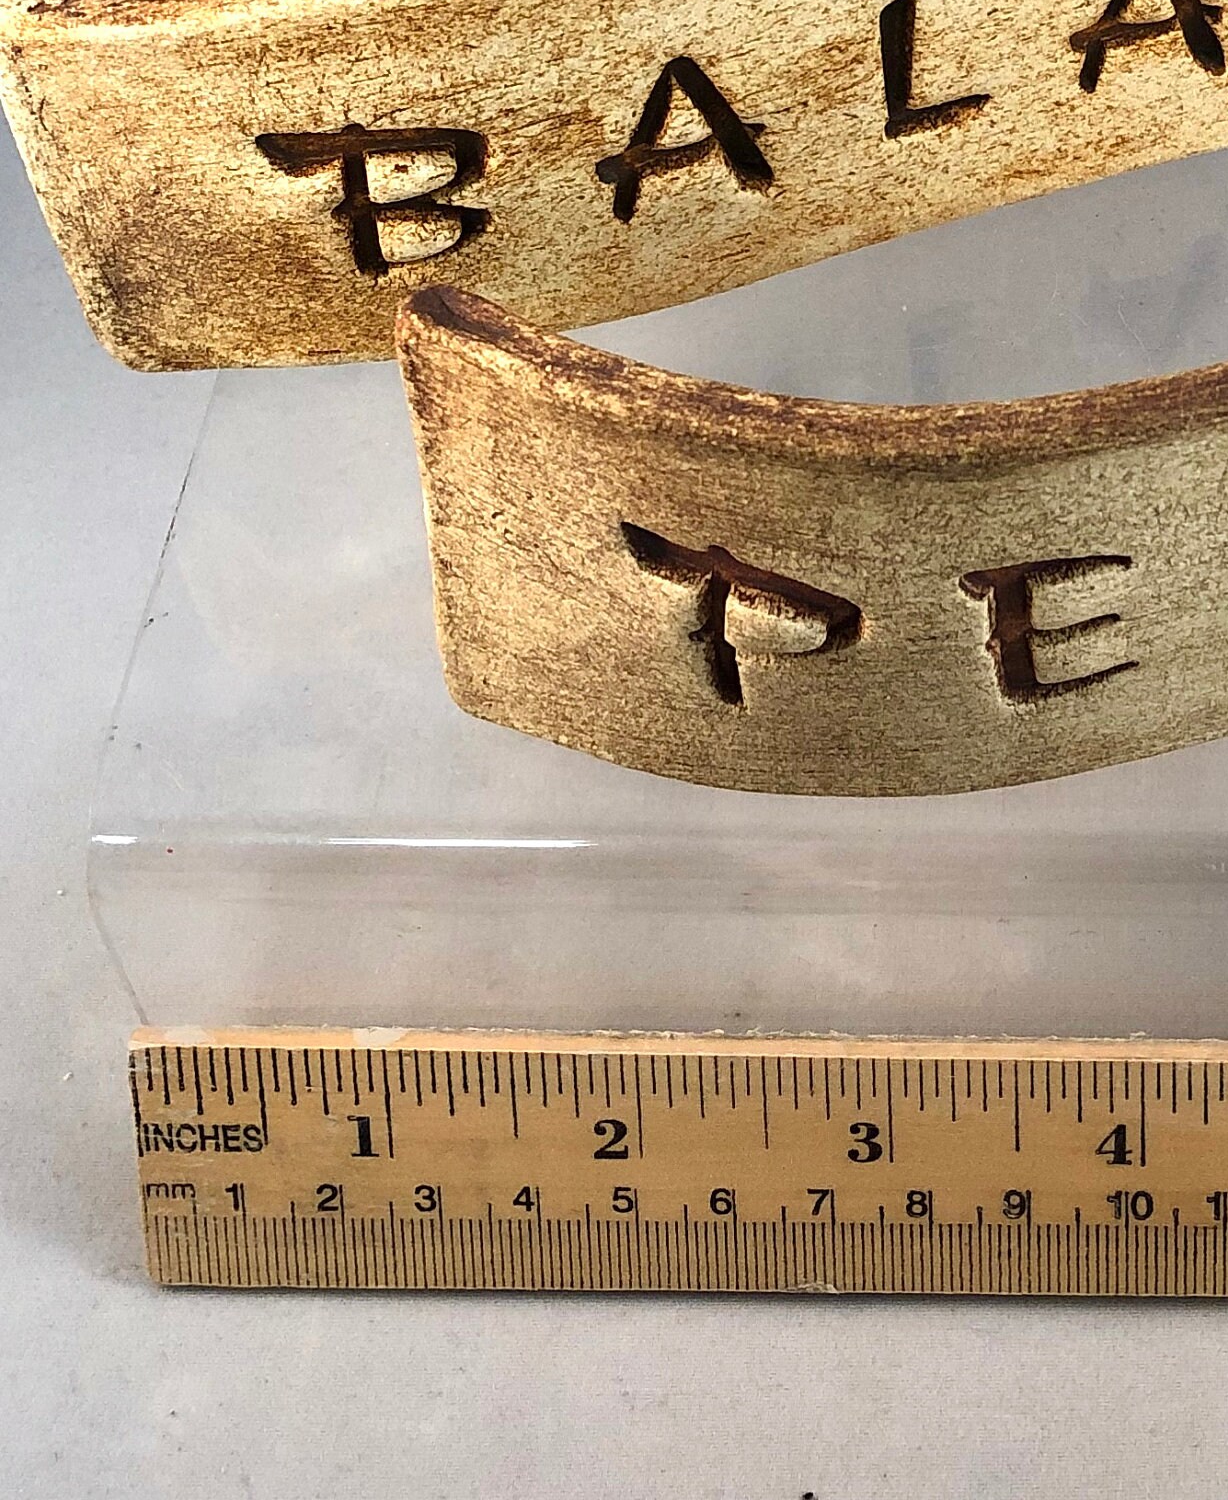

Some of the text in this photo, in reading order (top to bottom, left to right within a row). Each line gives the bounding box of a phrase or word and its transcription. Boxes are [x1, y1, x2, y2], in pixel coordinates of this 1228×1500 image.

[144, 1123, 263, 1153] INCHES
[348, 1115, 379, 1157] 1
[593, 1119, 630, 1159] 2
[848, 1122, 883, 1162] 3
[1095, 1124, 1132, 1166] 4
[146, 1183, 196, 1199] mm
[225, 1186, 241, 1211] 1
[316, 1186, 339, 1211] 2
[414, 1187, 438, 1212] 3
[512, 1188, 536, 1212] 4
[611, 1189, 635, 1213] 5
[709, 1189, 732, 1214] 6
[807, 1190, 829, 1214] 7
[906, 1191, 928, 1217] 8
[1002, 1192, 1026, 1218] 9
[1108, 1191, 1154, 1218] 10
